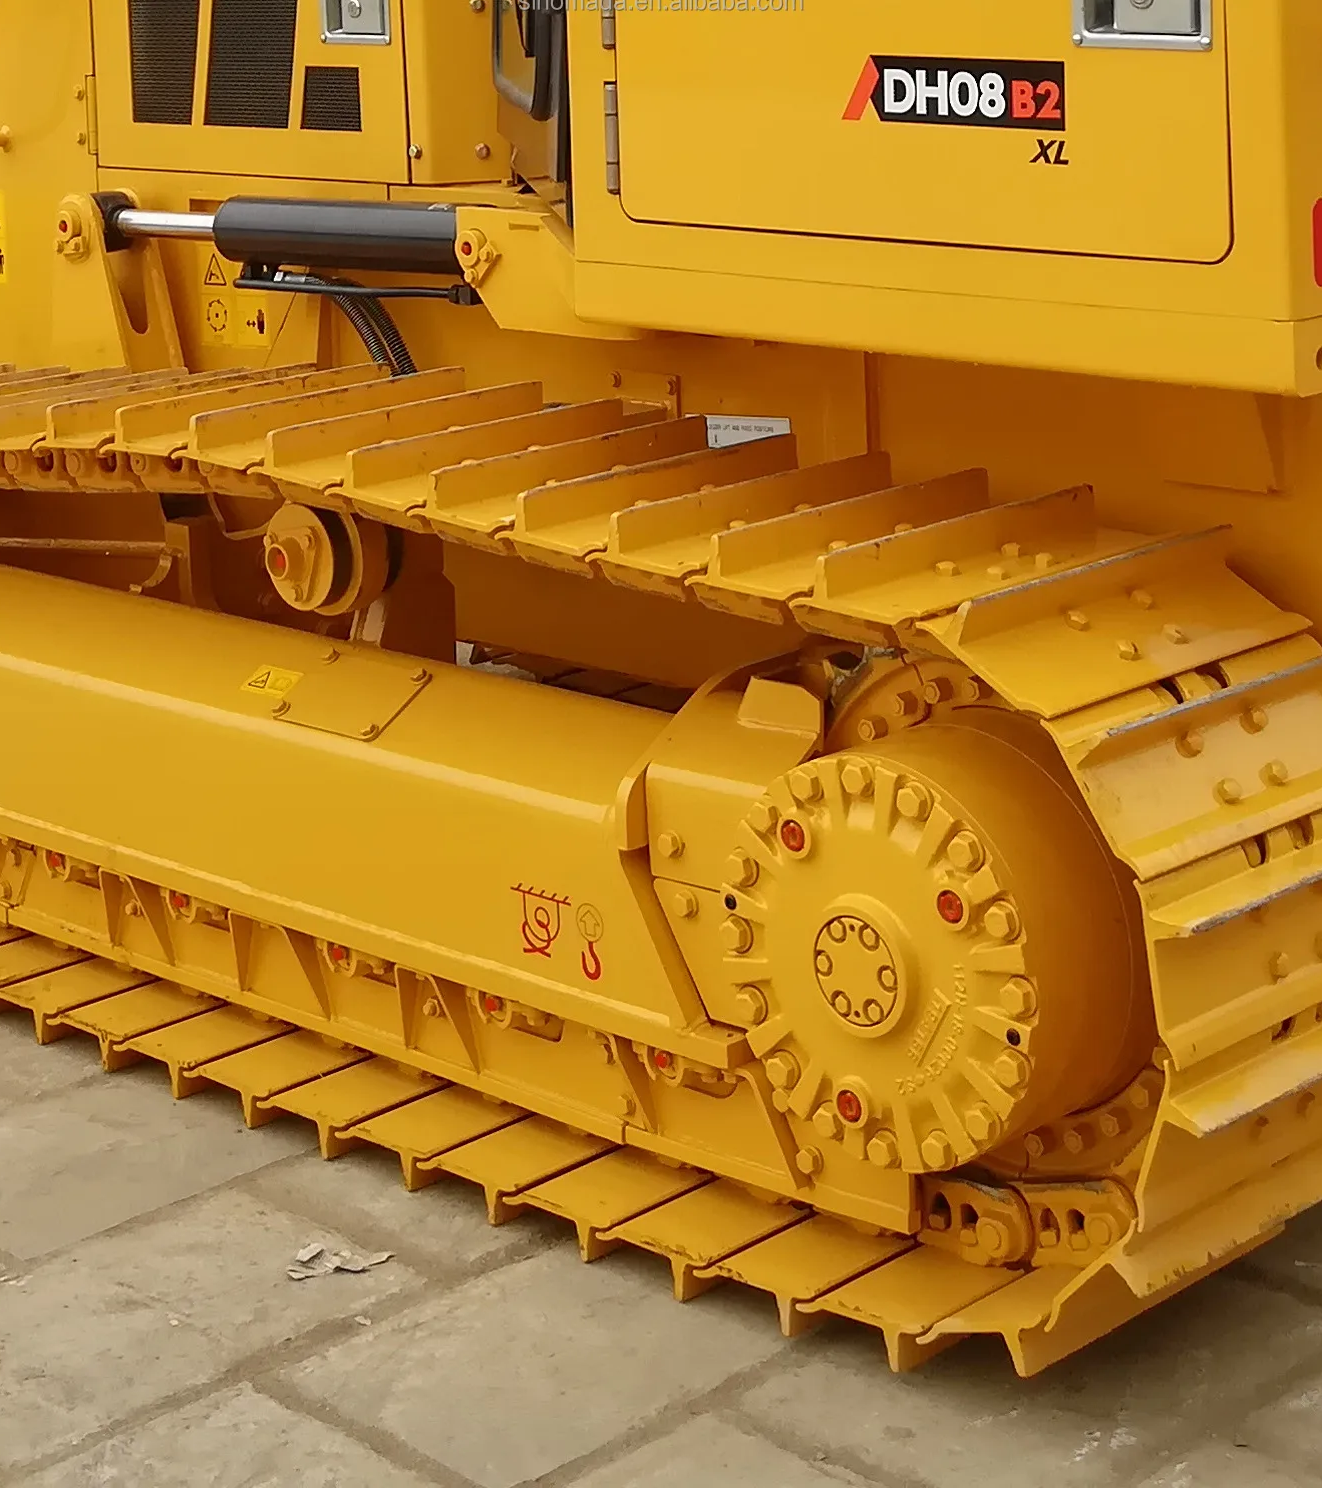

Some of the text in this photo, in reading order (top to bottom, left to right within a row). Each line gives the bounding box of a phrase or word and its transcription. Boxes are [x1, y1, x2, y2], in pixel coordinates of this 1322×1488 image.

[883, 68, 1062, 119] DH08 B2
[1029, 138, 1070, 165] XL
